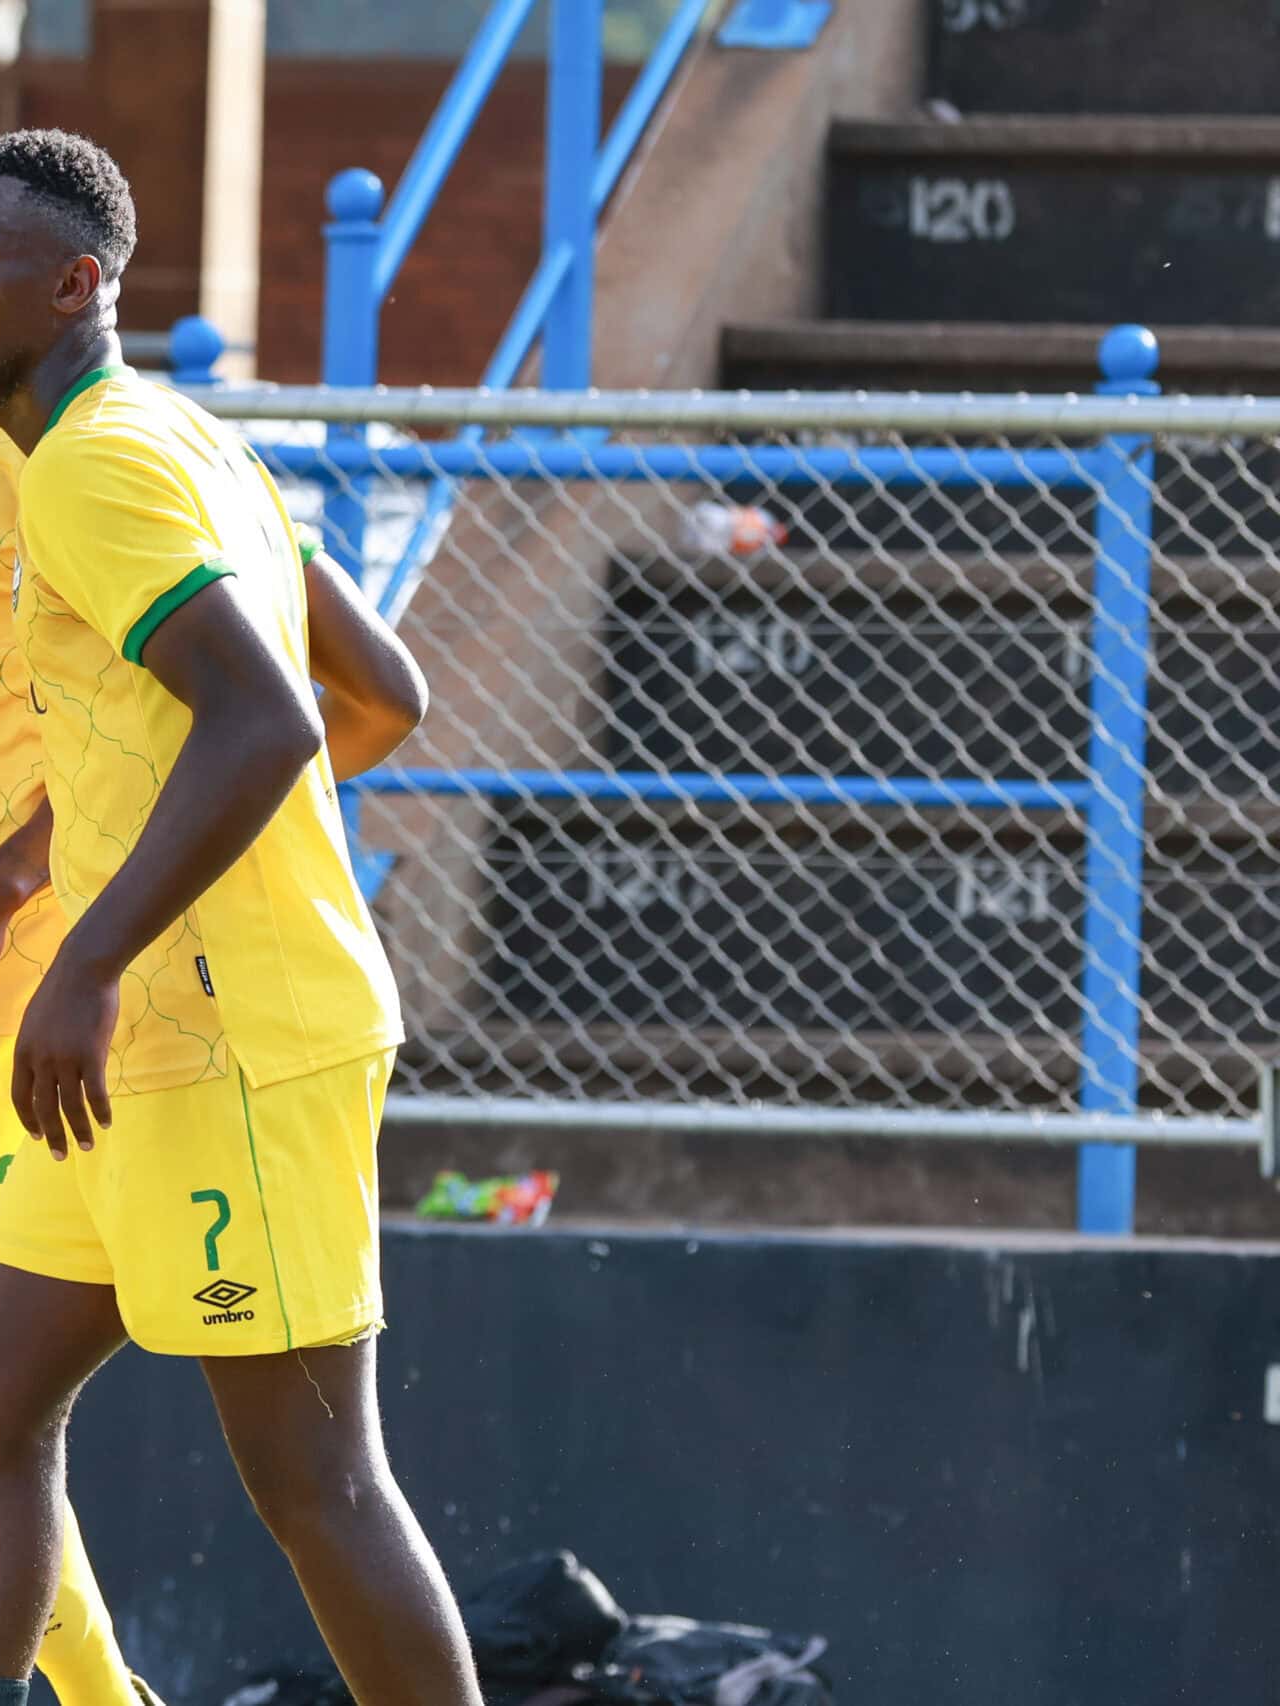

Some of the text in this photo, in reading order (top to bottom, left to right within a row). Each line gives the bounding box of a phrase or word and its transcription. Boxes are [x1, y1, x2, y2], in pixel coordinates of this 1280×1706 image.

[909, 178, 1015, 241] 120
[191, 1189, 231, 1271] 7
[203, 1310, 255, 1325] umbro
